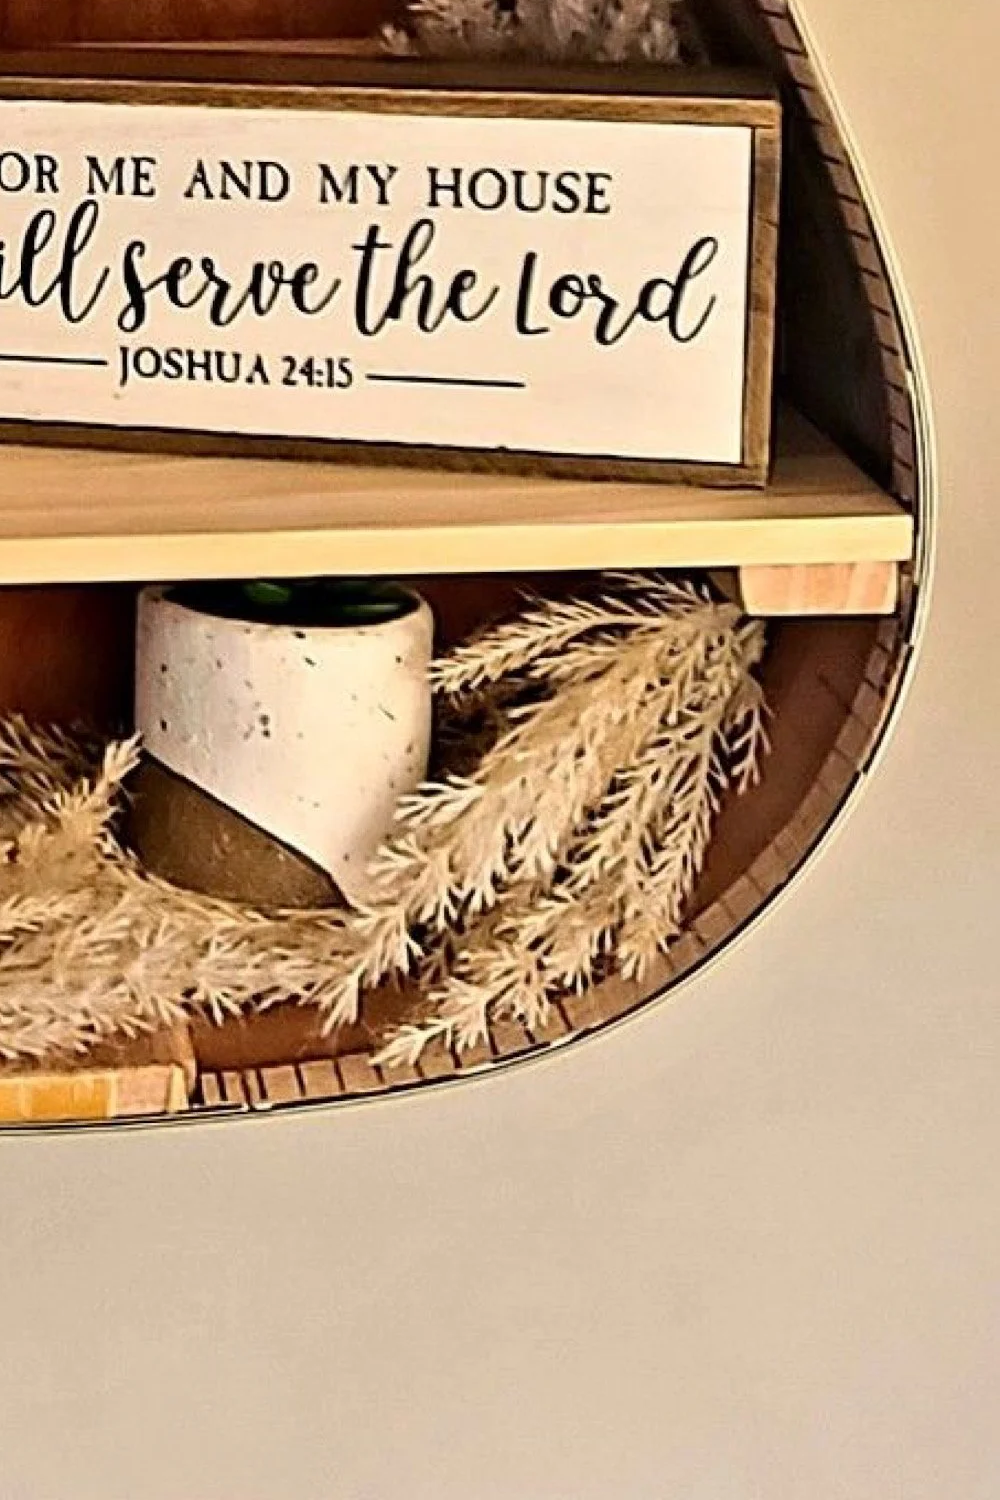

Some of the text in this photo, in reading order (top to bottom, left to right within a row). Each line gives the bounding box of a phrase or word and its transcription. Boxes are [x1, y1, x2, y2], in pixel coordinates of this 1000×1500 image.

[86, 155, 157, 198] ME
[183, 159, 290, 203] AND
[318, 163, 401, 210] MY
[427, 166, 613, 215] HOUSE
[117, 240, 342, 334] serve
[351, 217, 500, 338] the
[515, 235, 720, 347] Lord
[118, 345, 354, 389] JOSHUA 24:15
